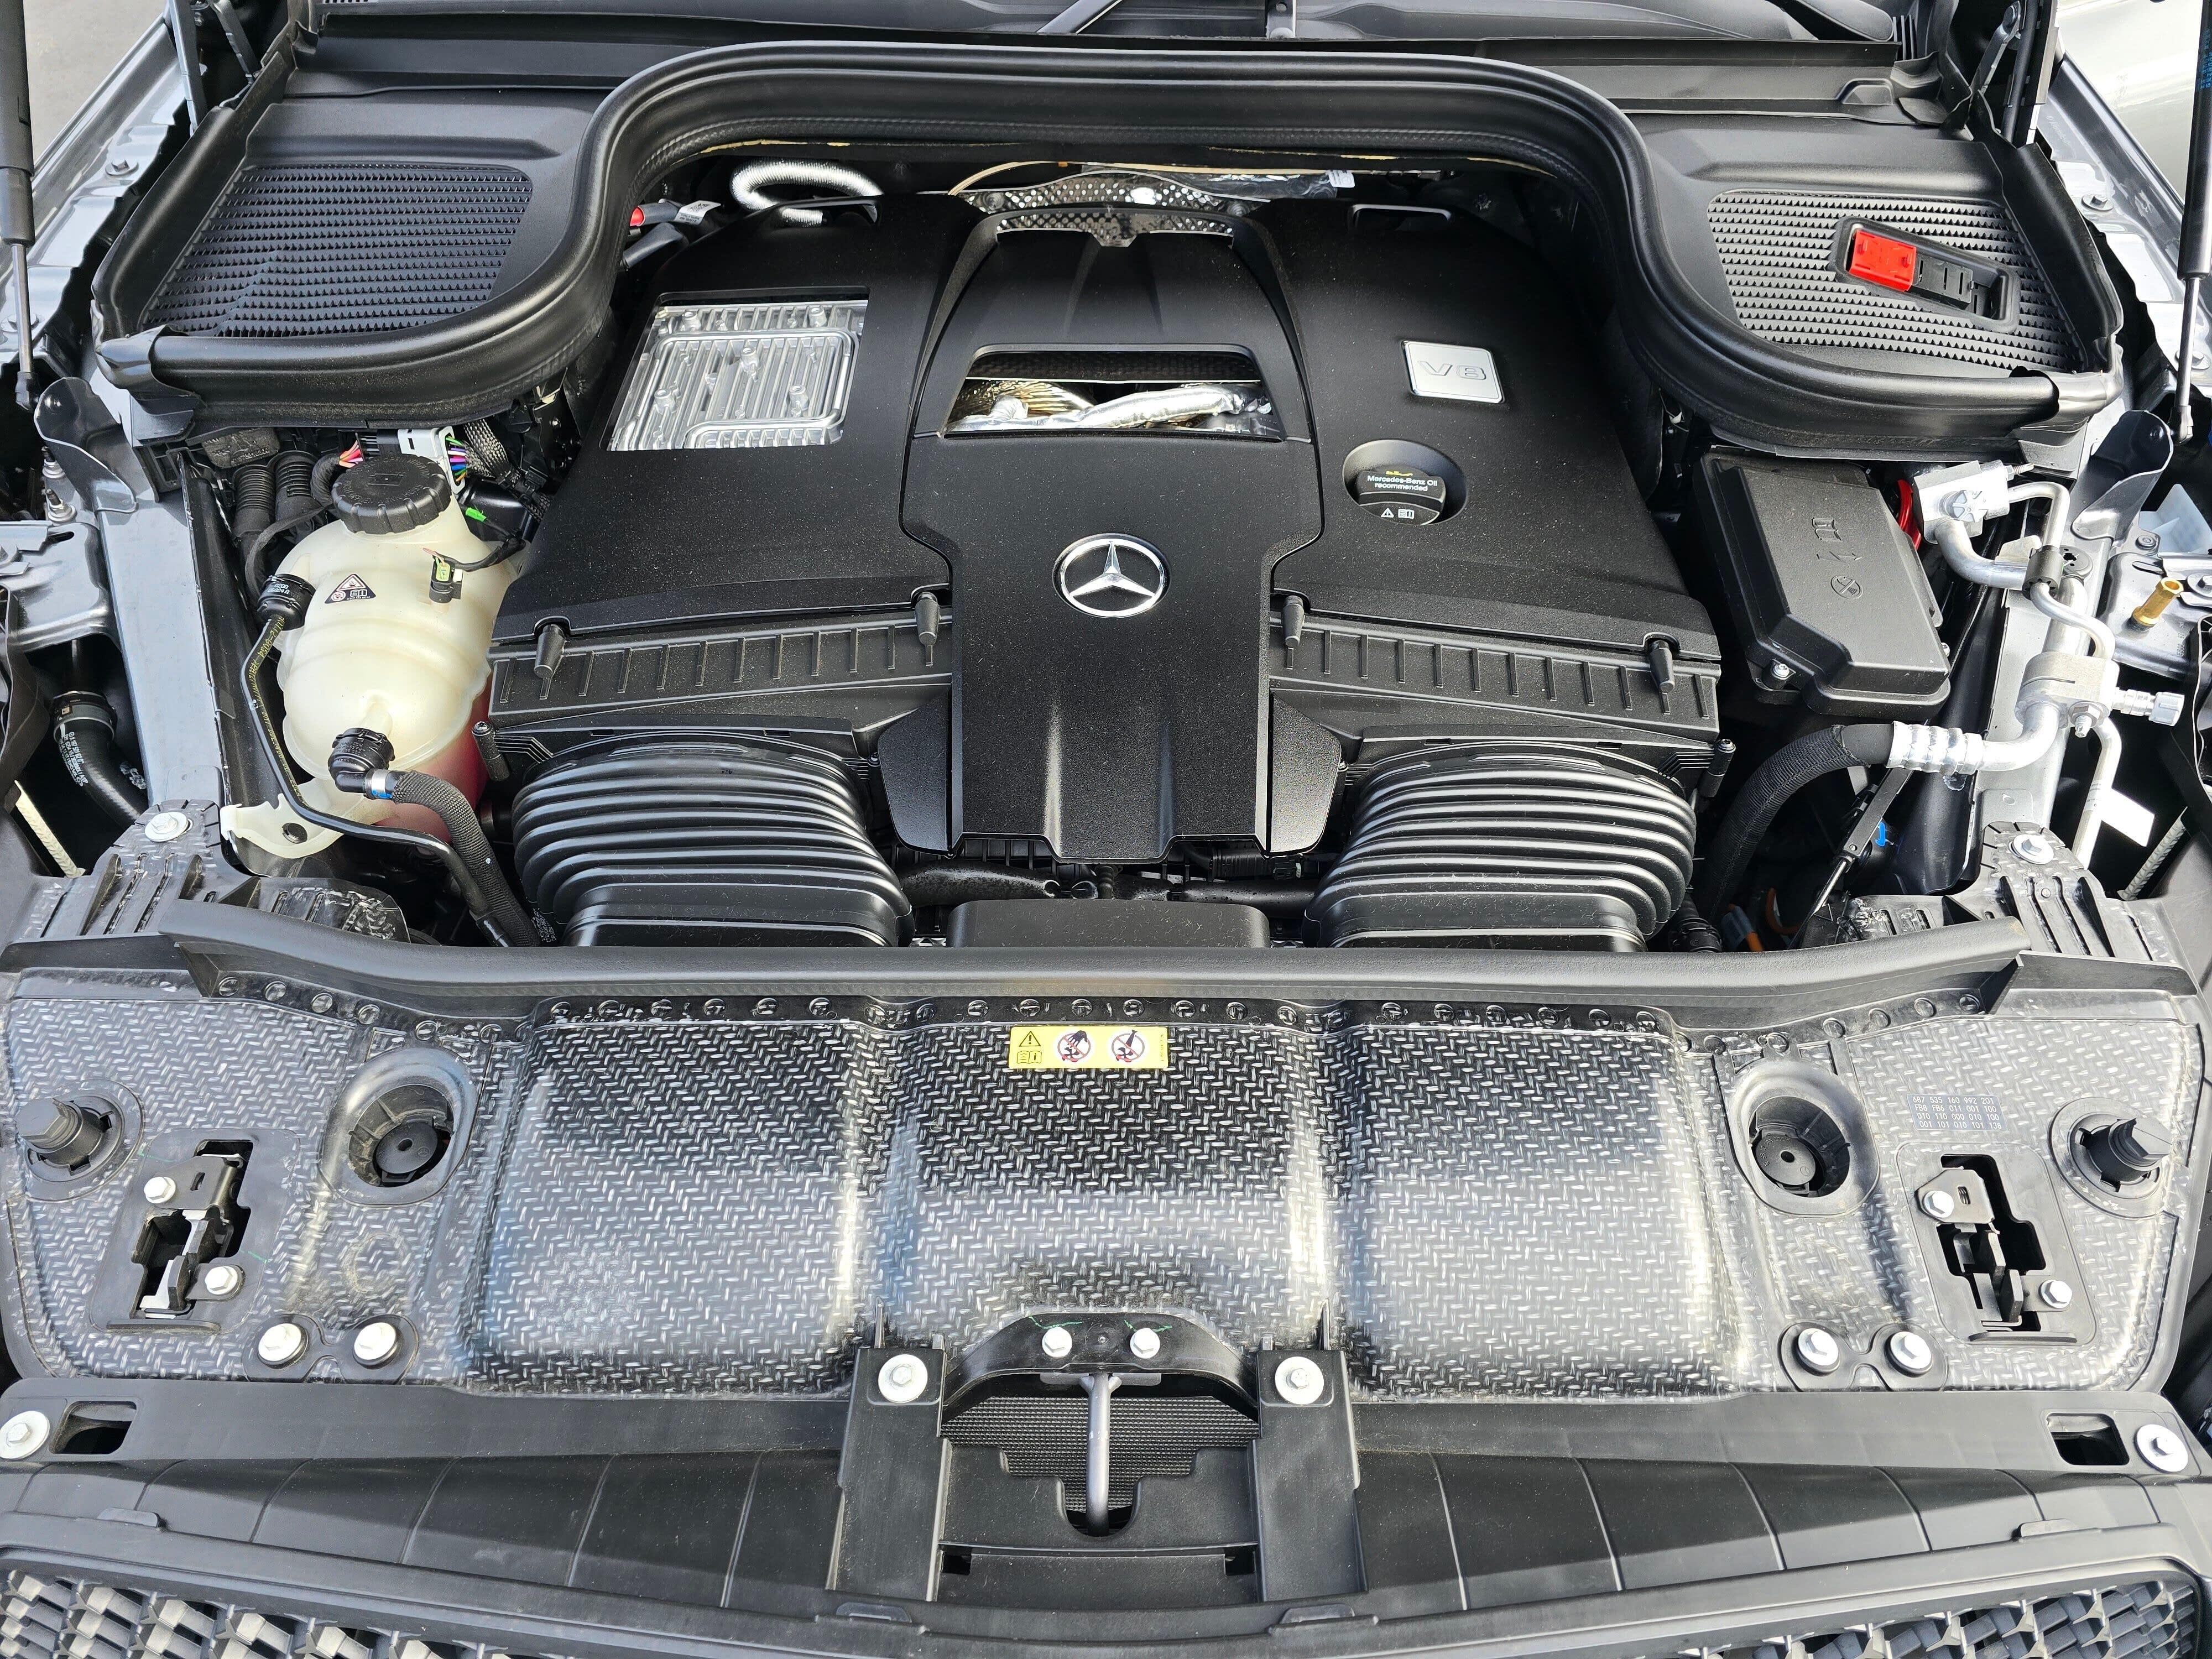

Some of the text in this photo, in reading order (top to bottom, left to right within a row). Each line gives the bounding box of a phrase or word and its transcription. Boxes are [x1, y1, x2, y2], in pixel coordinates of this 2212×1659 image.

[1417, 361, 1486, 380] V8
[1367, 476, 1426, 486] Mercedes-Benz
[1374, 482, 1428, 492] recommended
